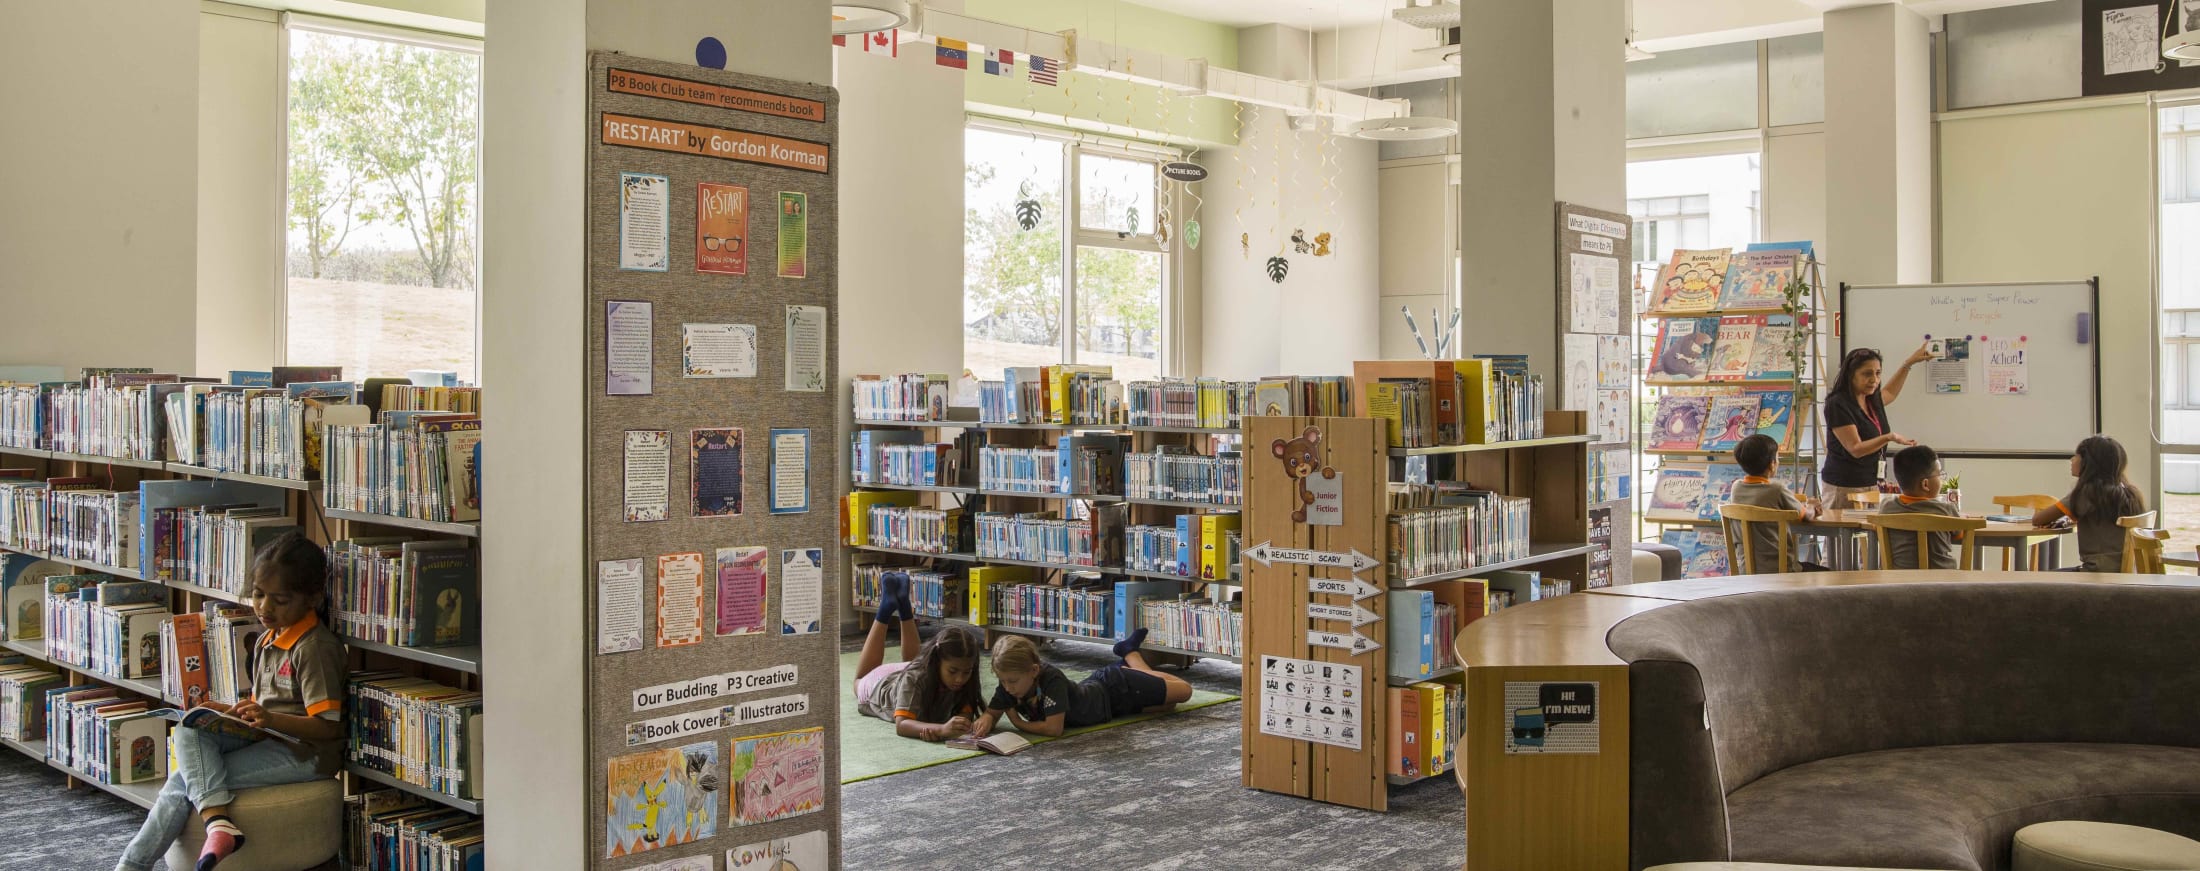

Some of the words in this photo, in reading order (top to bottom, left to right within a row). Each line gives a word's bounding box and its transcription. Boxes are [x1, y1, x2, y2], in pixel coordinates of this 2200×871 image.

[611, 75, 626, 88] P8
[629, 78, 658, 93] Book
[661, 83, 686, 97] Club
[688, 88, 716, 101] team
[720, 94, 787, 112] recommends
[789, 102, 814, 116] book
[688, 131, 706, 152] by
[710, 135, 766, 157] Gordon
[770, 143, 826, 167] Korman
[1168, 167, 1186, 175] PICTURE
[1186, 168, 1201, 176] BOOKS
[1570, 217, 1584, 229] What
[1584, 240, 1599, 249] means
[1600, 241, 1605, 250] to
[1717, 331, 1751, 340] BEAR
[1316, 492, 1337, 500] Junior
[1602, 527, 1610, 537] NO
[1271, 550, 1309, 560] REALISTIC
[1318, 555, 1341, 563] SCARY
[1593, 549, 1611, 562] SHELF
[1317, 582, 1346, 591] SPORTS
[1322, 635, 1339, 644] WAR
[638, 693, 662, 706] Our
[667, 683, 718, 701] Budding
[727, 677, 742, 690] P3
[746, 671, 794, 687] Creative
[1561, 691, 1575, 702] HI!
[1545, 705, 1562, 714] I'm
[1563, 705, 1591, 715] NEW!
[647, 720, 679, 738] Book
[683, 716, 718, 731] Cover
[741, 701, 805, 720] Illustrators
